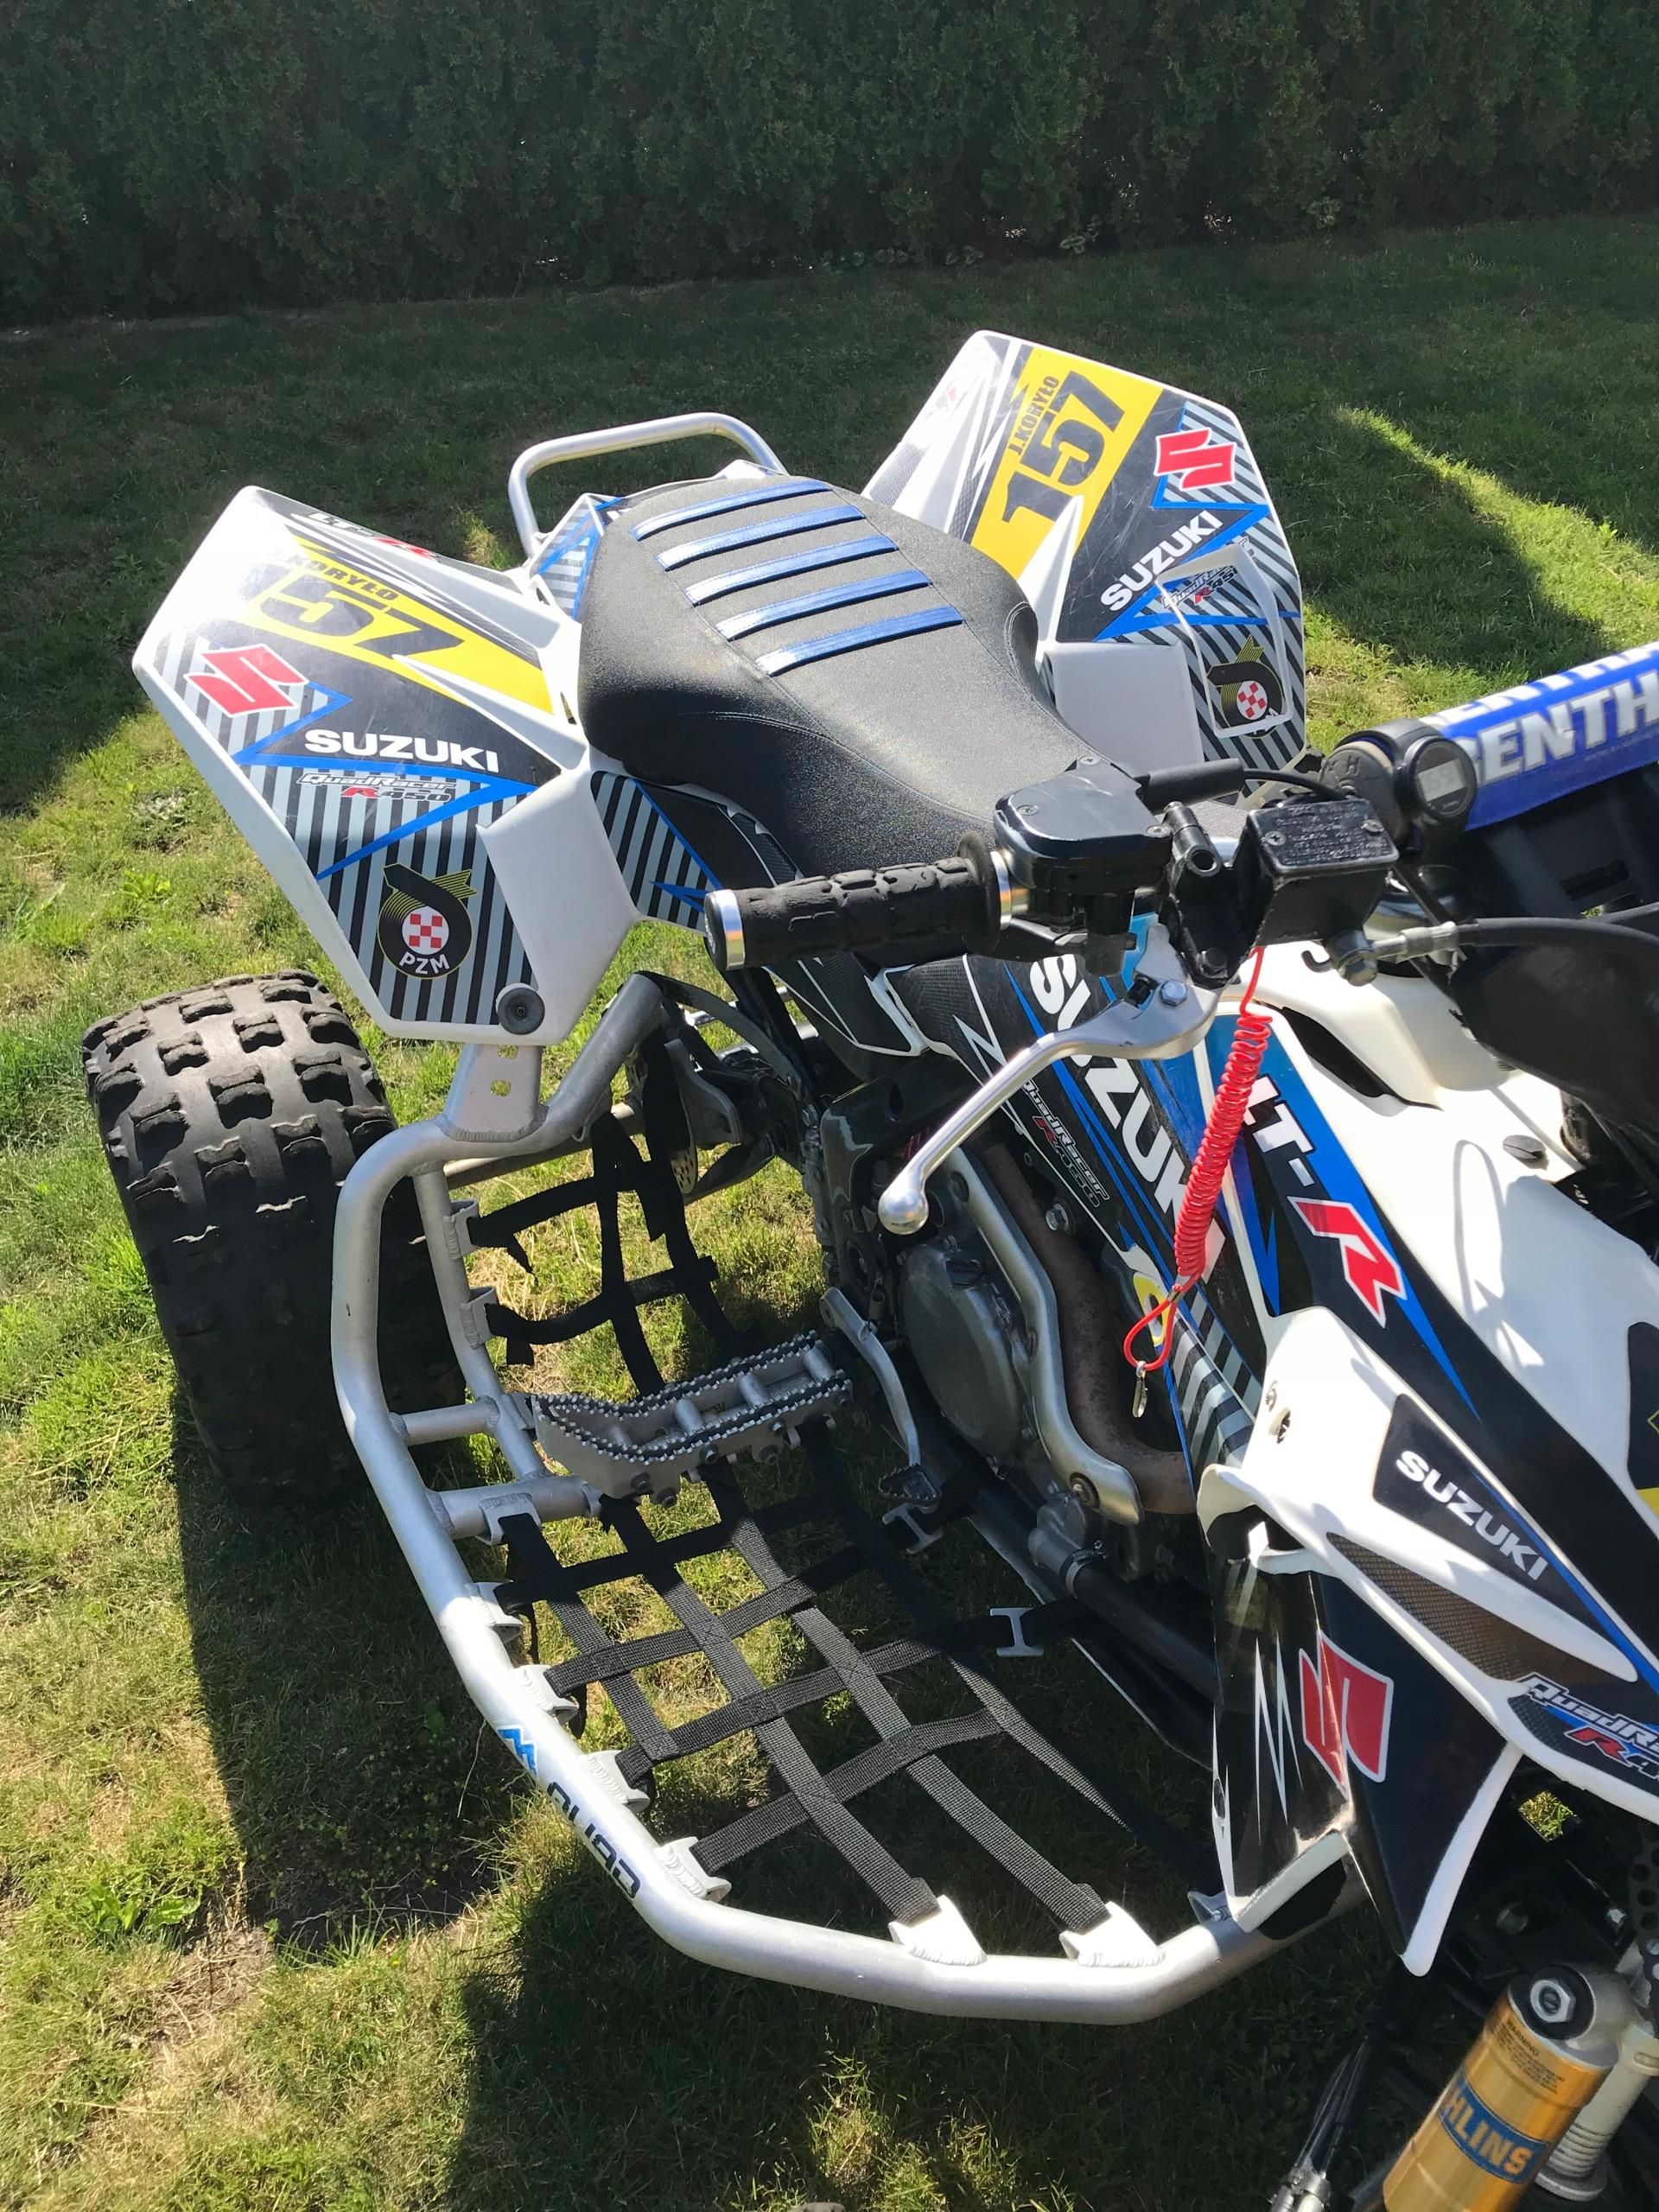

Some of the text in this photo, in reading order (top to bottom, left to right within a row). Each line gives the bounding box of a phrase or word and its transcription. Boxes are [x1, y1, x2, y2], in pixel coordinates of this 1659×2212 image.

[1001, 370, 1125, 523] 157
[1101, 510, 1224, 611] SUZUKI
[296, 772, 456, 791] QuadRacer
[304, 728, 499, 773] SUZUKI
[340, 787, 451, 802] R450
[399, 951, 450, 975] PZM
[1033, 1116, 1100, 1207] R450
[1395, 1451, 1548, 1581] SUZUKI
[1444, 2087, 1534, 2176] HLINS
